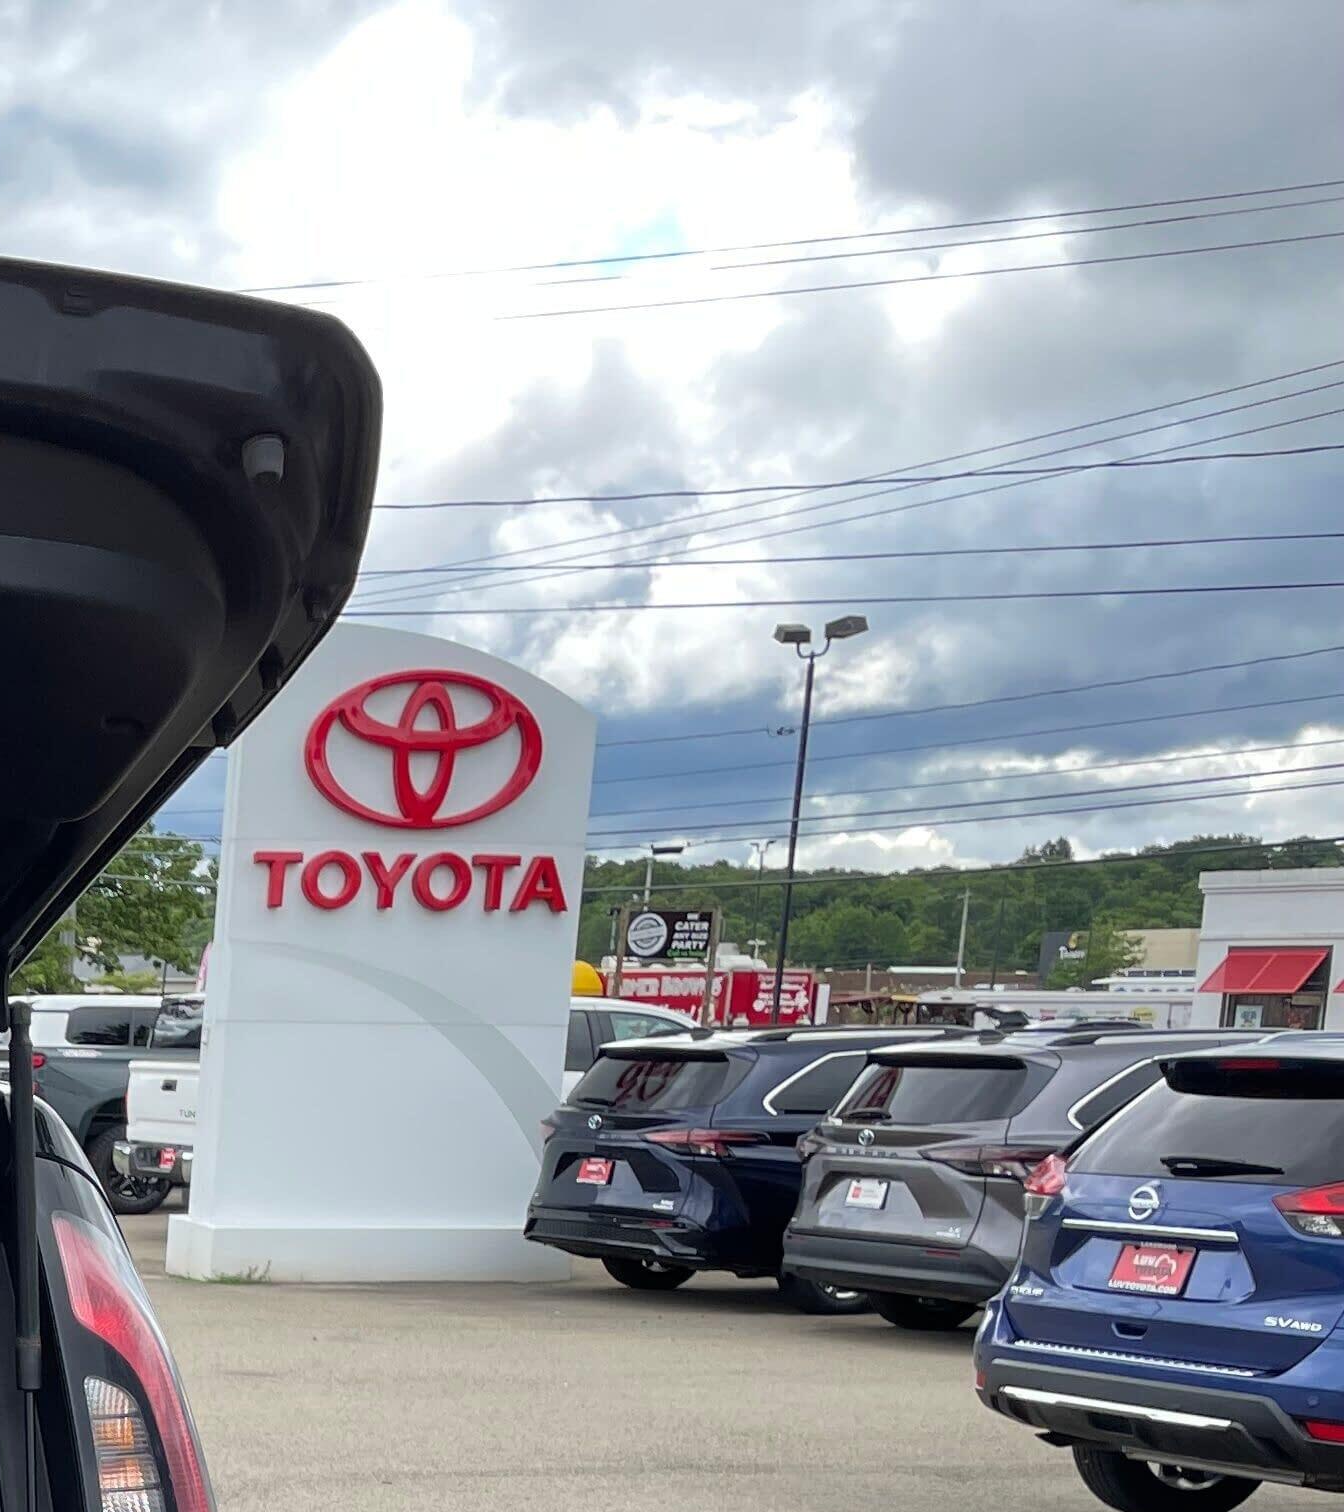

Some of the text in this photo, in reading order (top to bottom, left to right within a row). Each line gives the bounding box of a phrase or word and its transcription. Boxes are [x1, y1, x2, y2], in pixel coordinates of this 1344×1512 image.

[254, 850, 567, 911] TOYOTA
[675, 921, 709, 931] CATER
[671, 940, 706, 950] PARTY
[179, 1109, 196, 1118] TUN
[1133, 1254, 1157, 1266] LUV
[1264, 1316, 1322, 1332] SV AWD
